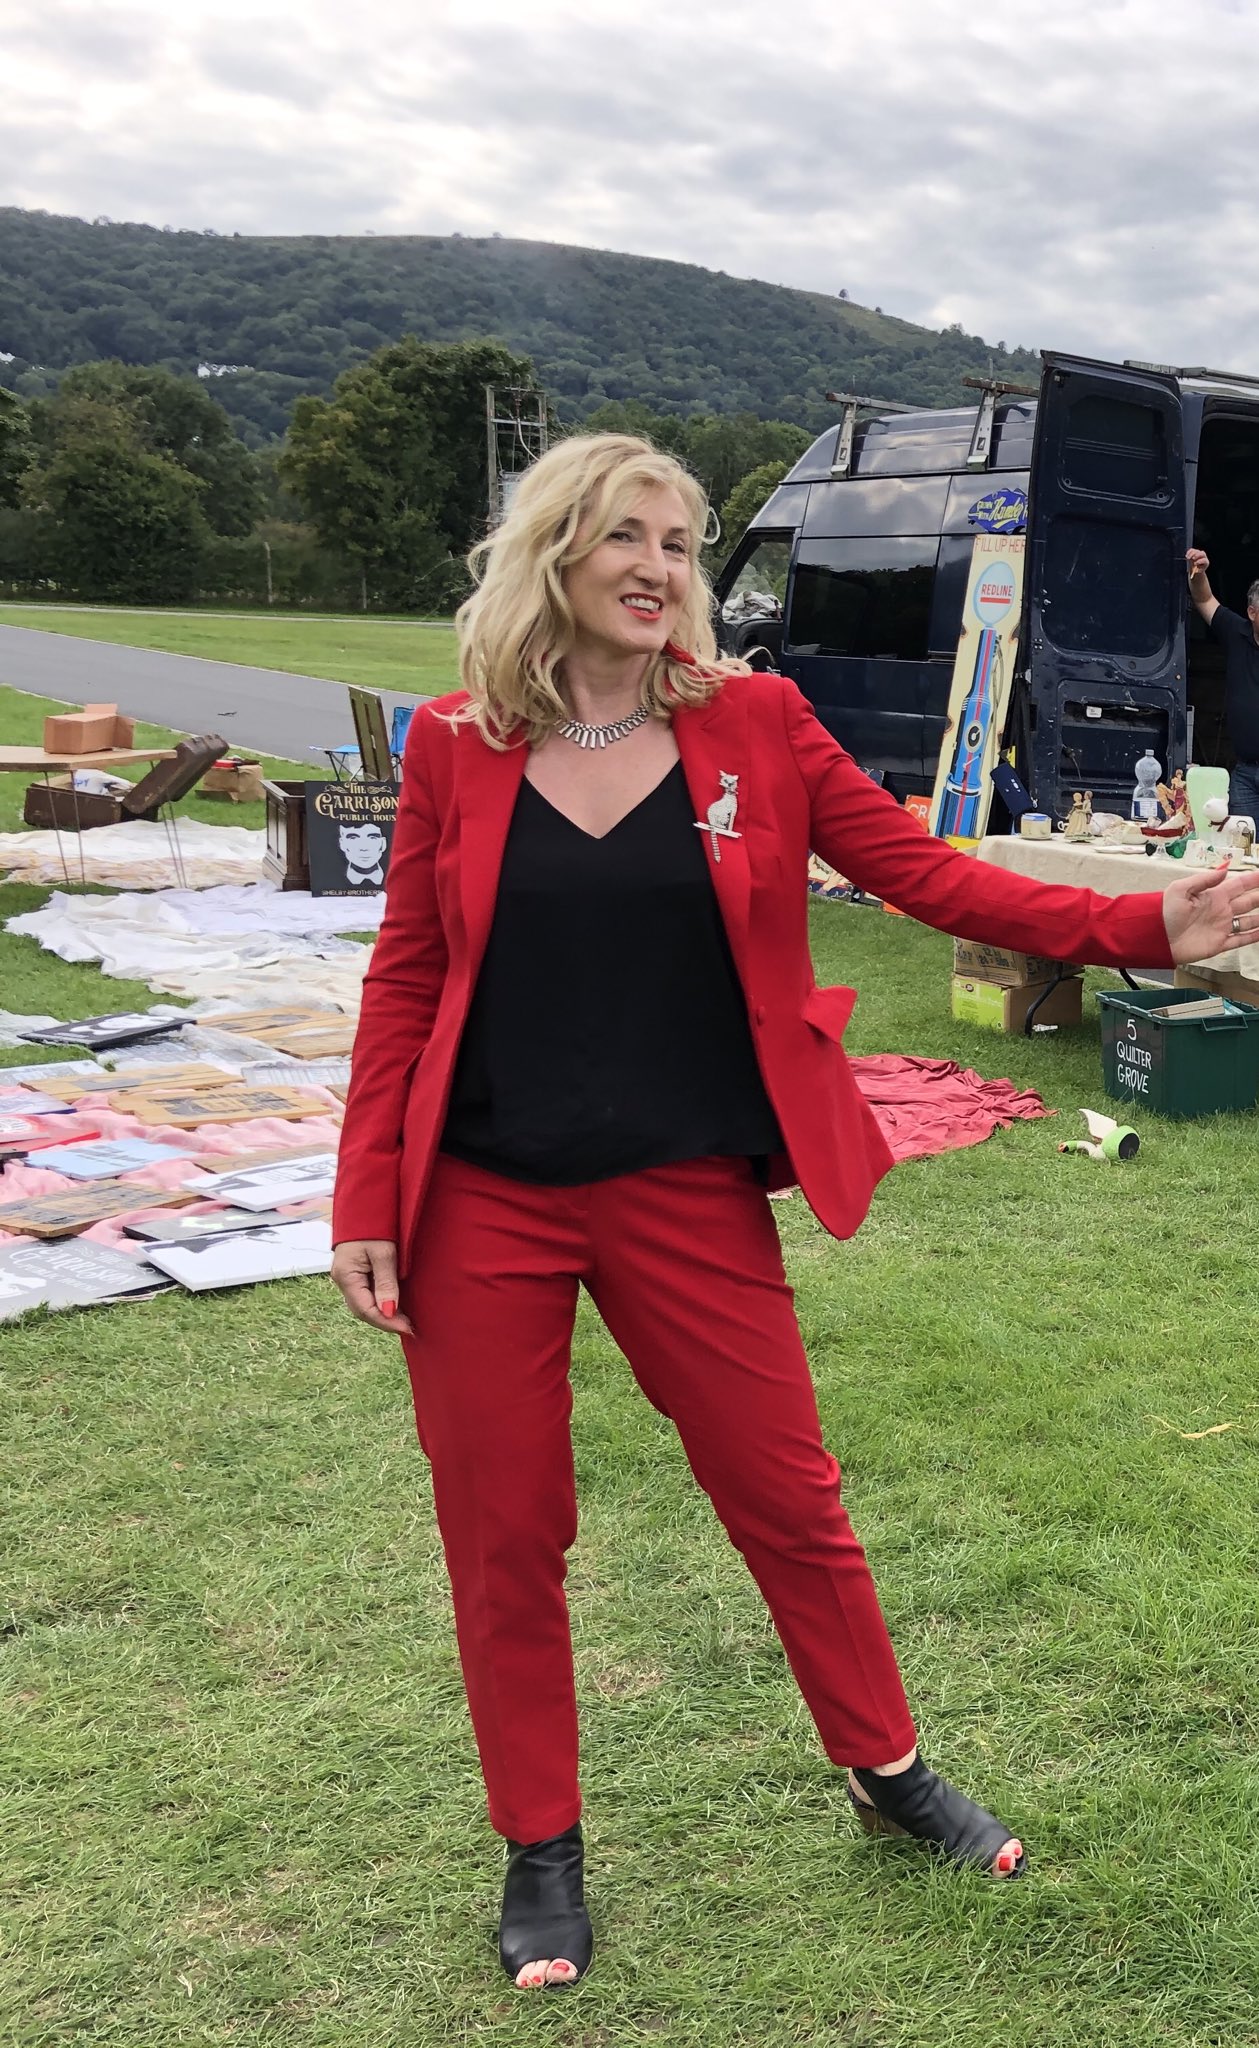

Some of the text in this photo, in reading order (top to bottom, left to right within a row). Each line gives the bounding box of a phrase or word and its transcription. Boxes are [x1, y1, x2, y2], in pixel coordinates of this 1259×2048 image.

[975, 536, 992, 552] FILL
[995, 538, 1008, 552] UP
[981, 583, 1014, 597] REDLINE
[314, 792, 400, 819] GARRISON
[339, 813, 397, 821] PUBLIC HOUS
[1126, 1018, 1137, 1041] 5
[1116, 1040, 1152, 1070] QUILTER
[1117, 1063, 1149, 1094] GROVE
